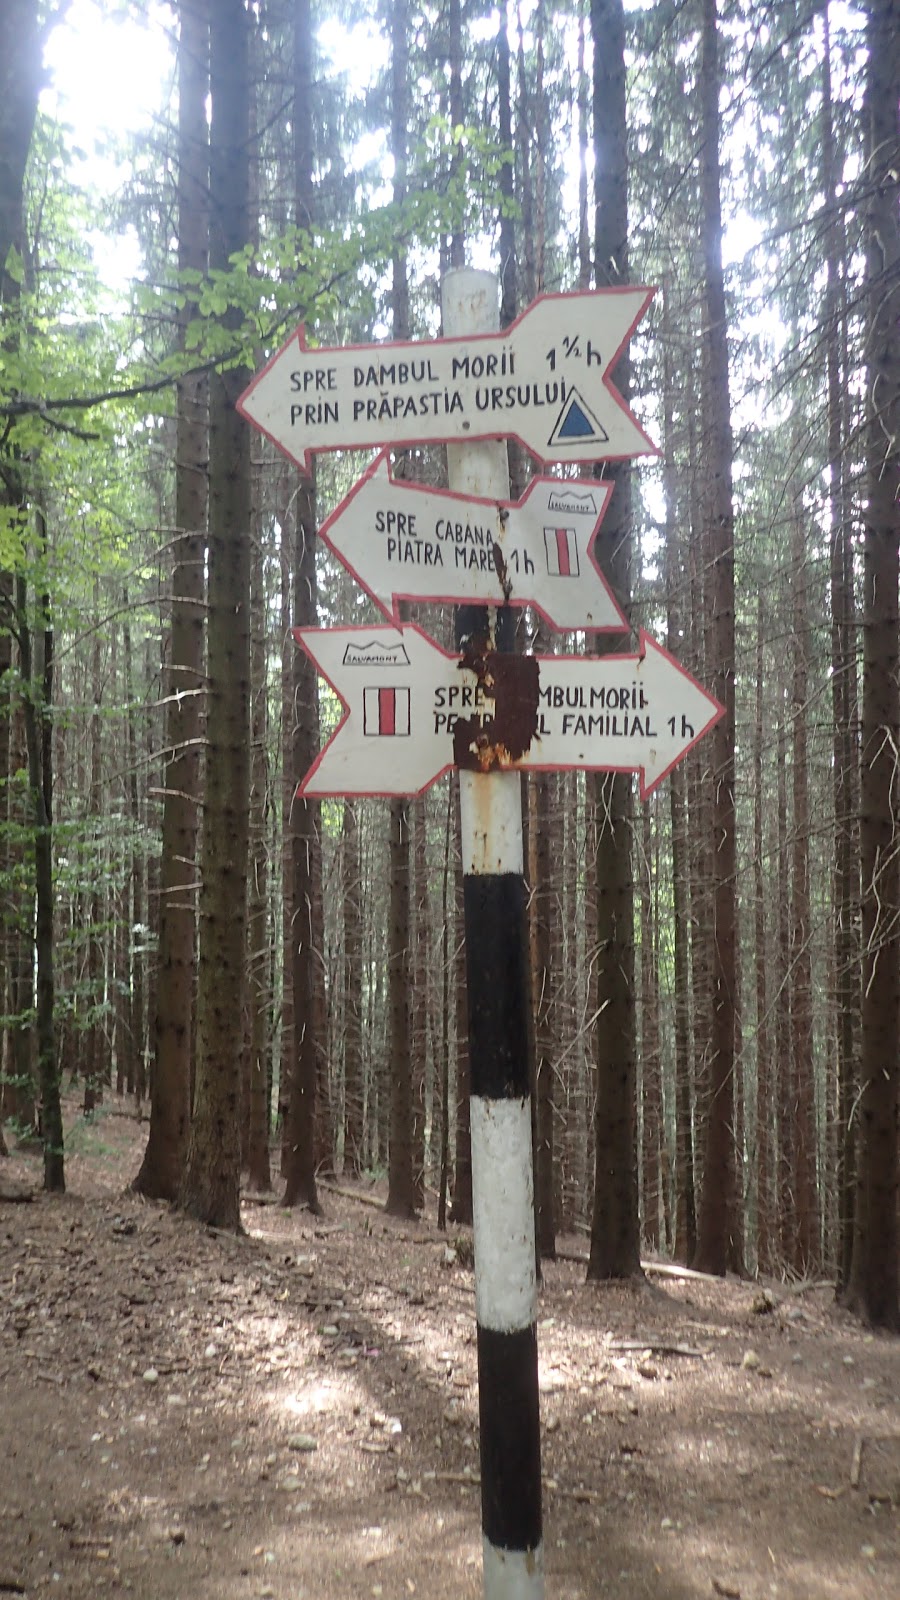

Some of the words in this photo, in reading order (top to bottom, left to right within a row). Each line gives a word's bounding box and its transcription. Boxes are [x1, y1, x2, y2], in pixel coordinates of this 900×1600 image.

[290, 368, 338, 392] SPRE
[353, 360, 440, 388] DAMBUL
[375, 511, 418, 538] SPRE
[435, 519, 494, 548] CABANA
[387, 538, 444, 567] PIATRA
[454, 545, 496, 572] MARE
[434, 685, 485, 707] SPRE
